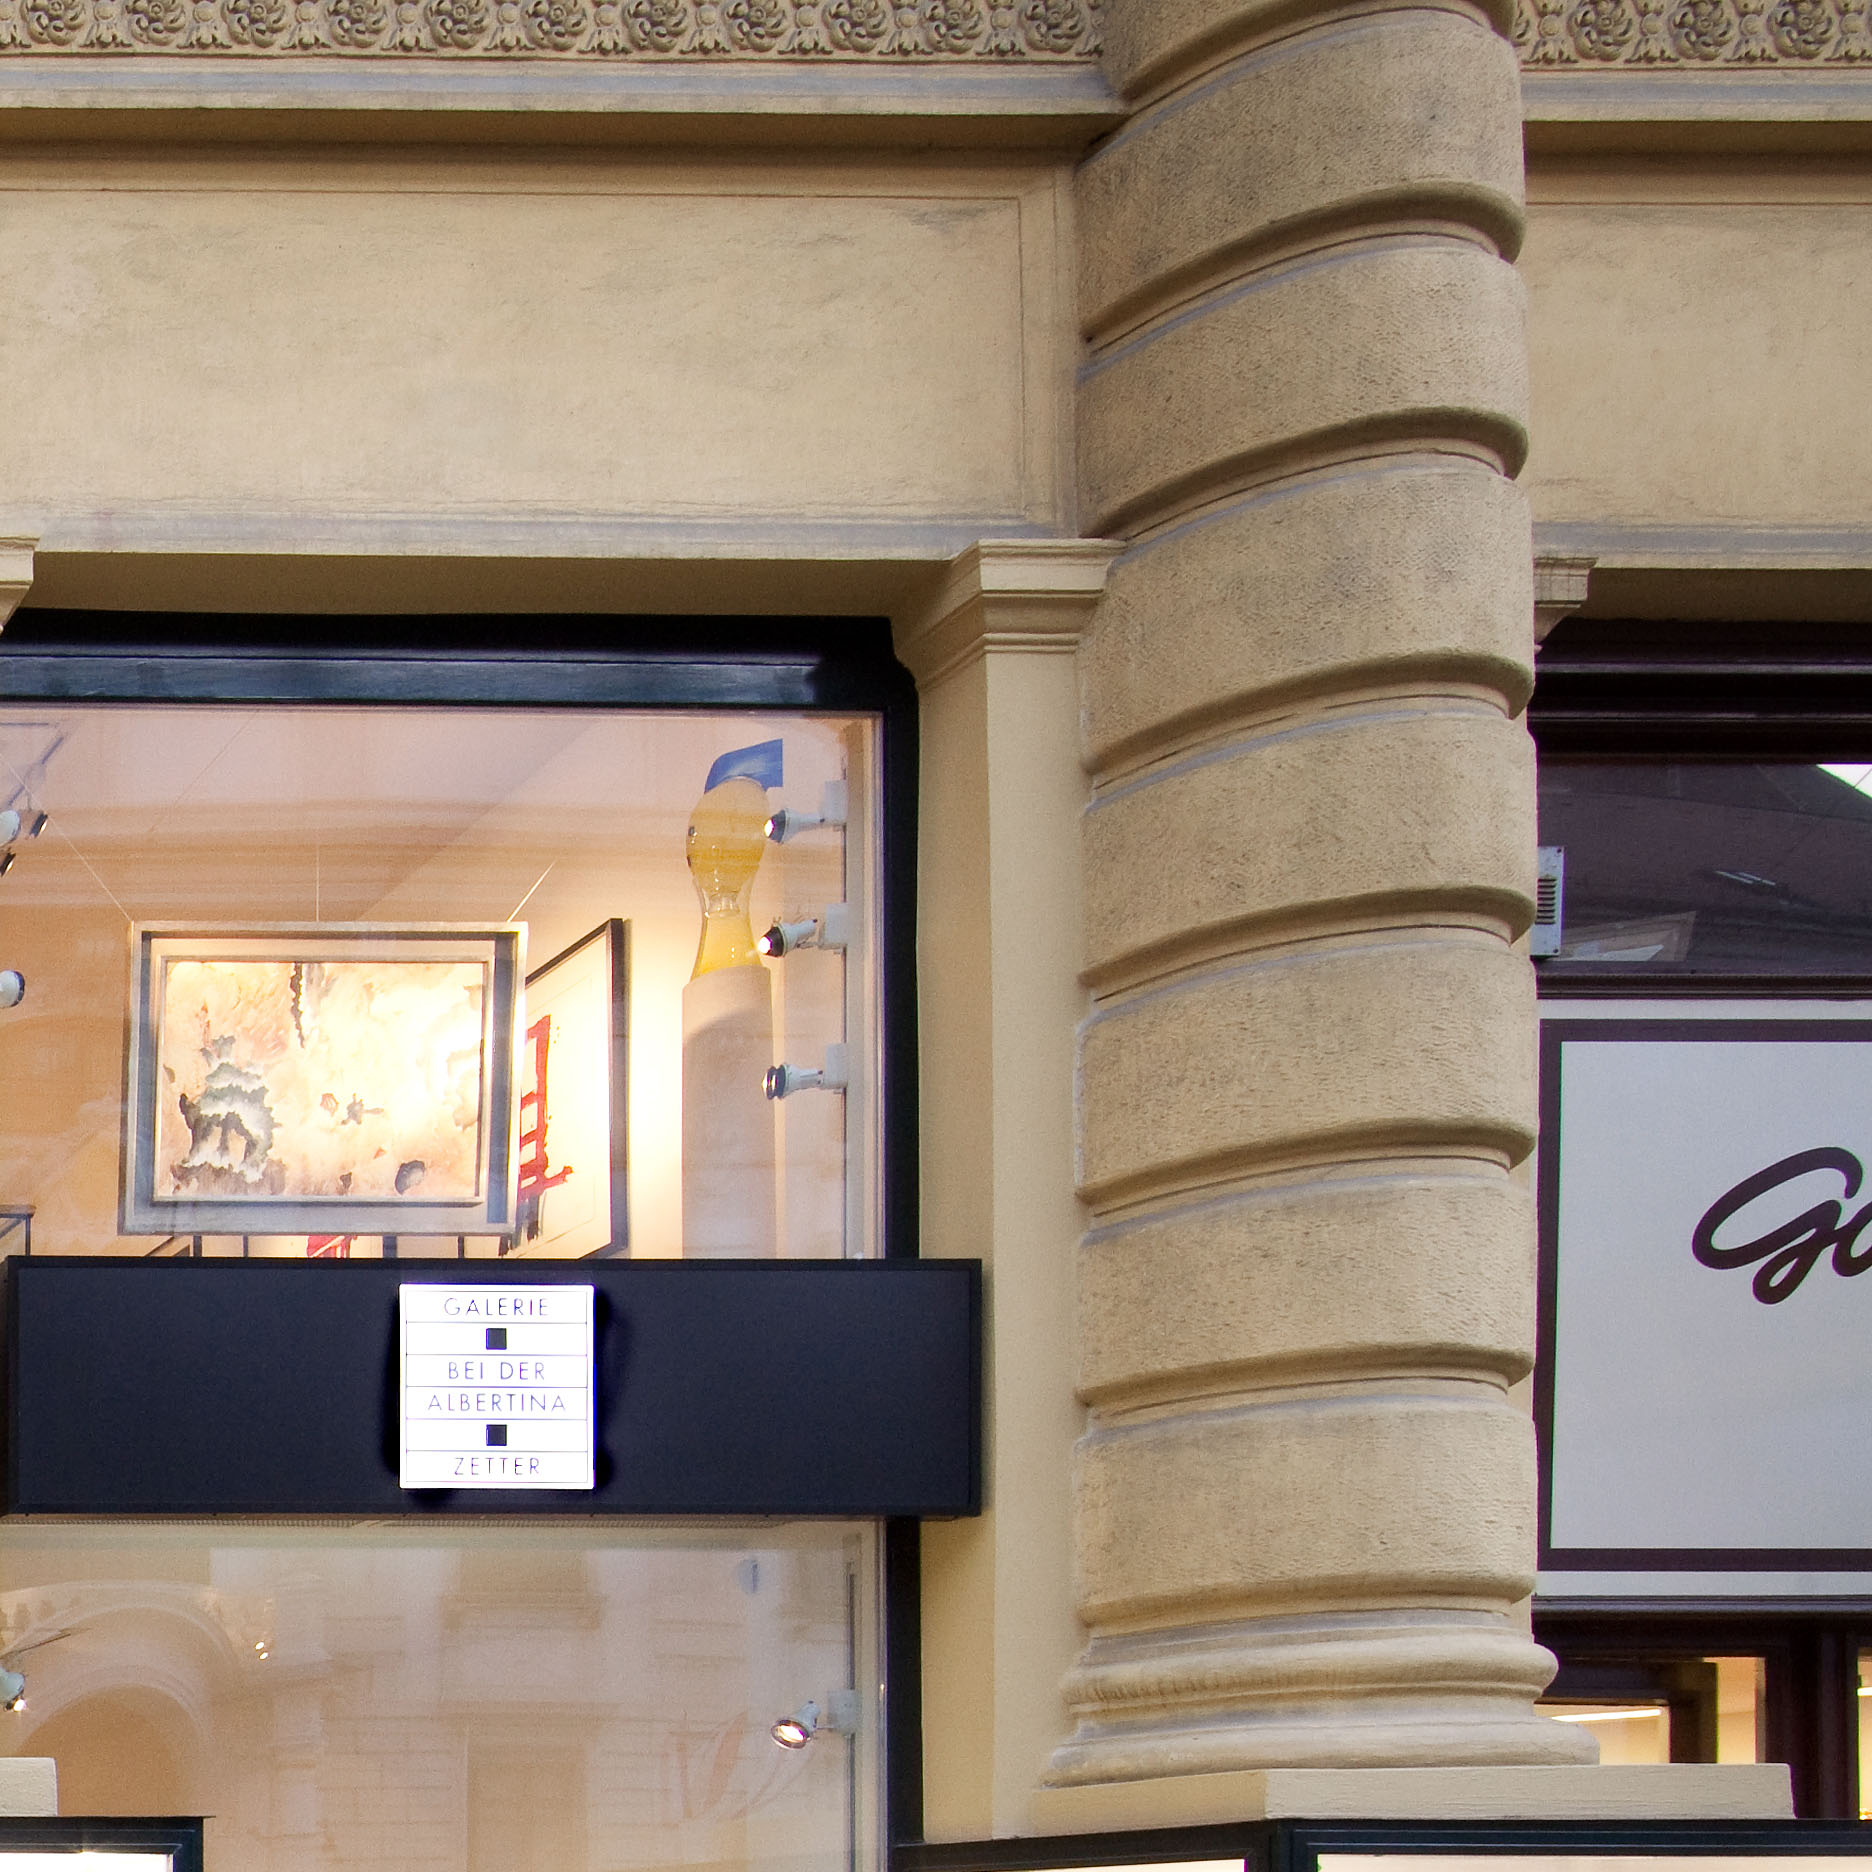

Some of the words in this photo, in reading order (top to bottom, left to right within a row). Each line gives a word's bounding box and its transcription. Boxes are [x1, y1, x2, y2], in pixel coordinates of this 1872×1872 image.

[443, 1297, 549, 1316] GALERIE
[448, 1361, 484, 1380] BEI
[499, 1361, 545, 1380] DER
[427, 1393, 566, 1412] ALBERTINA
[453, 1457, 541, 1476] ZETTER
